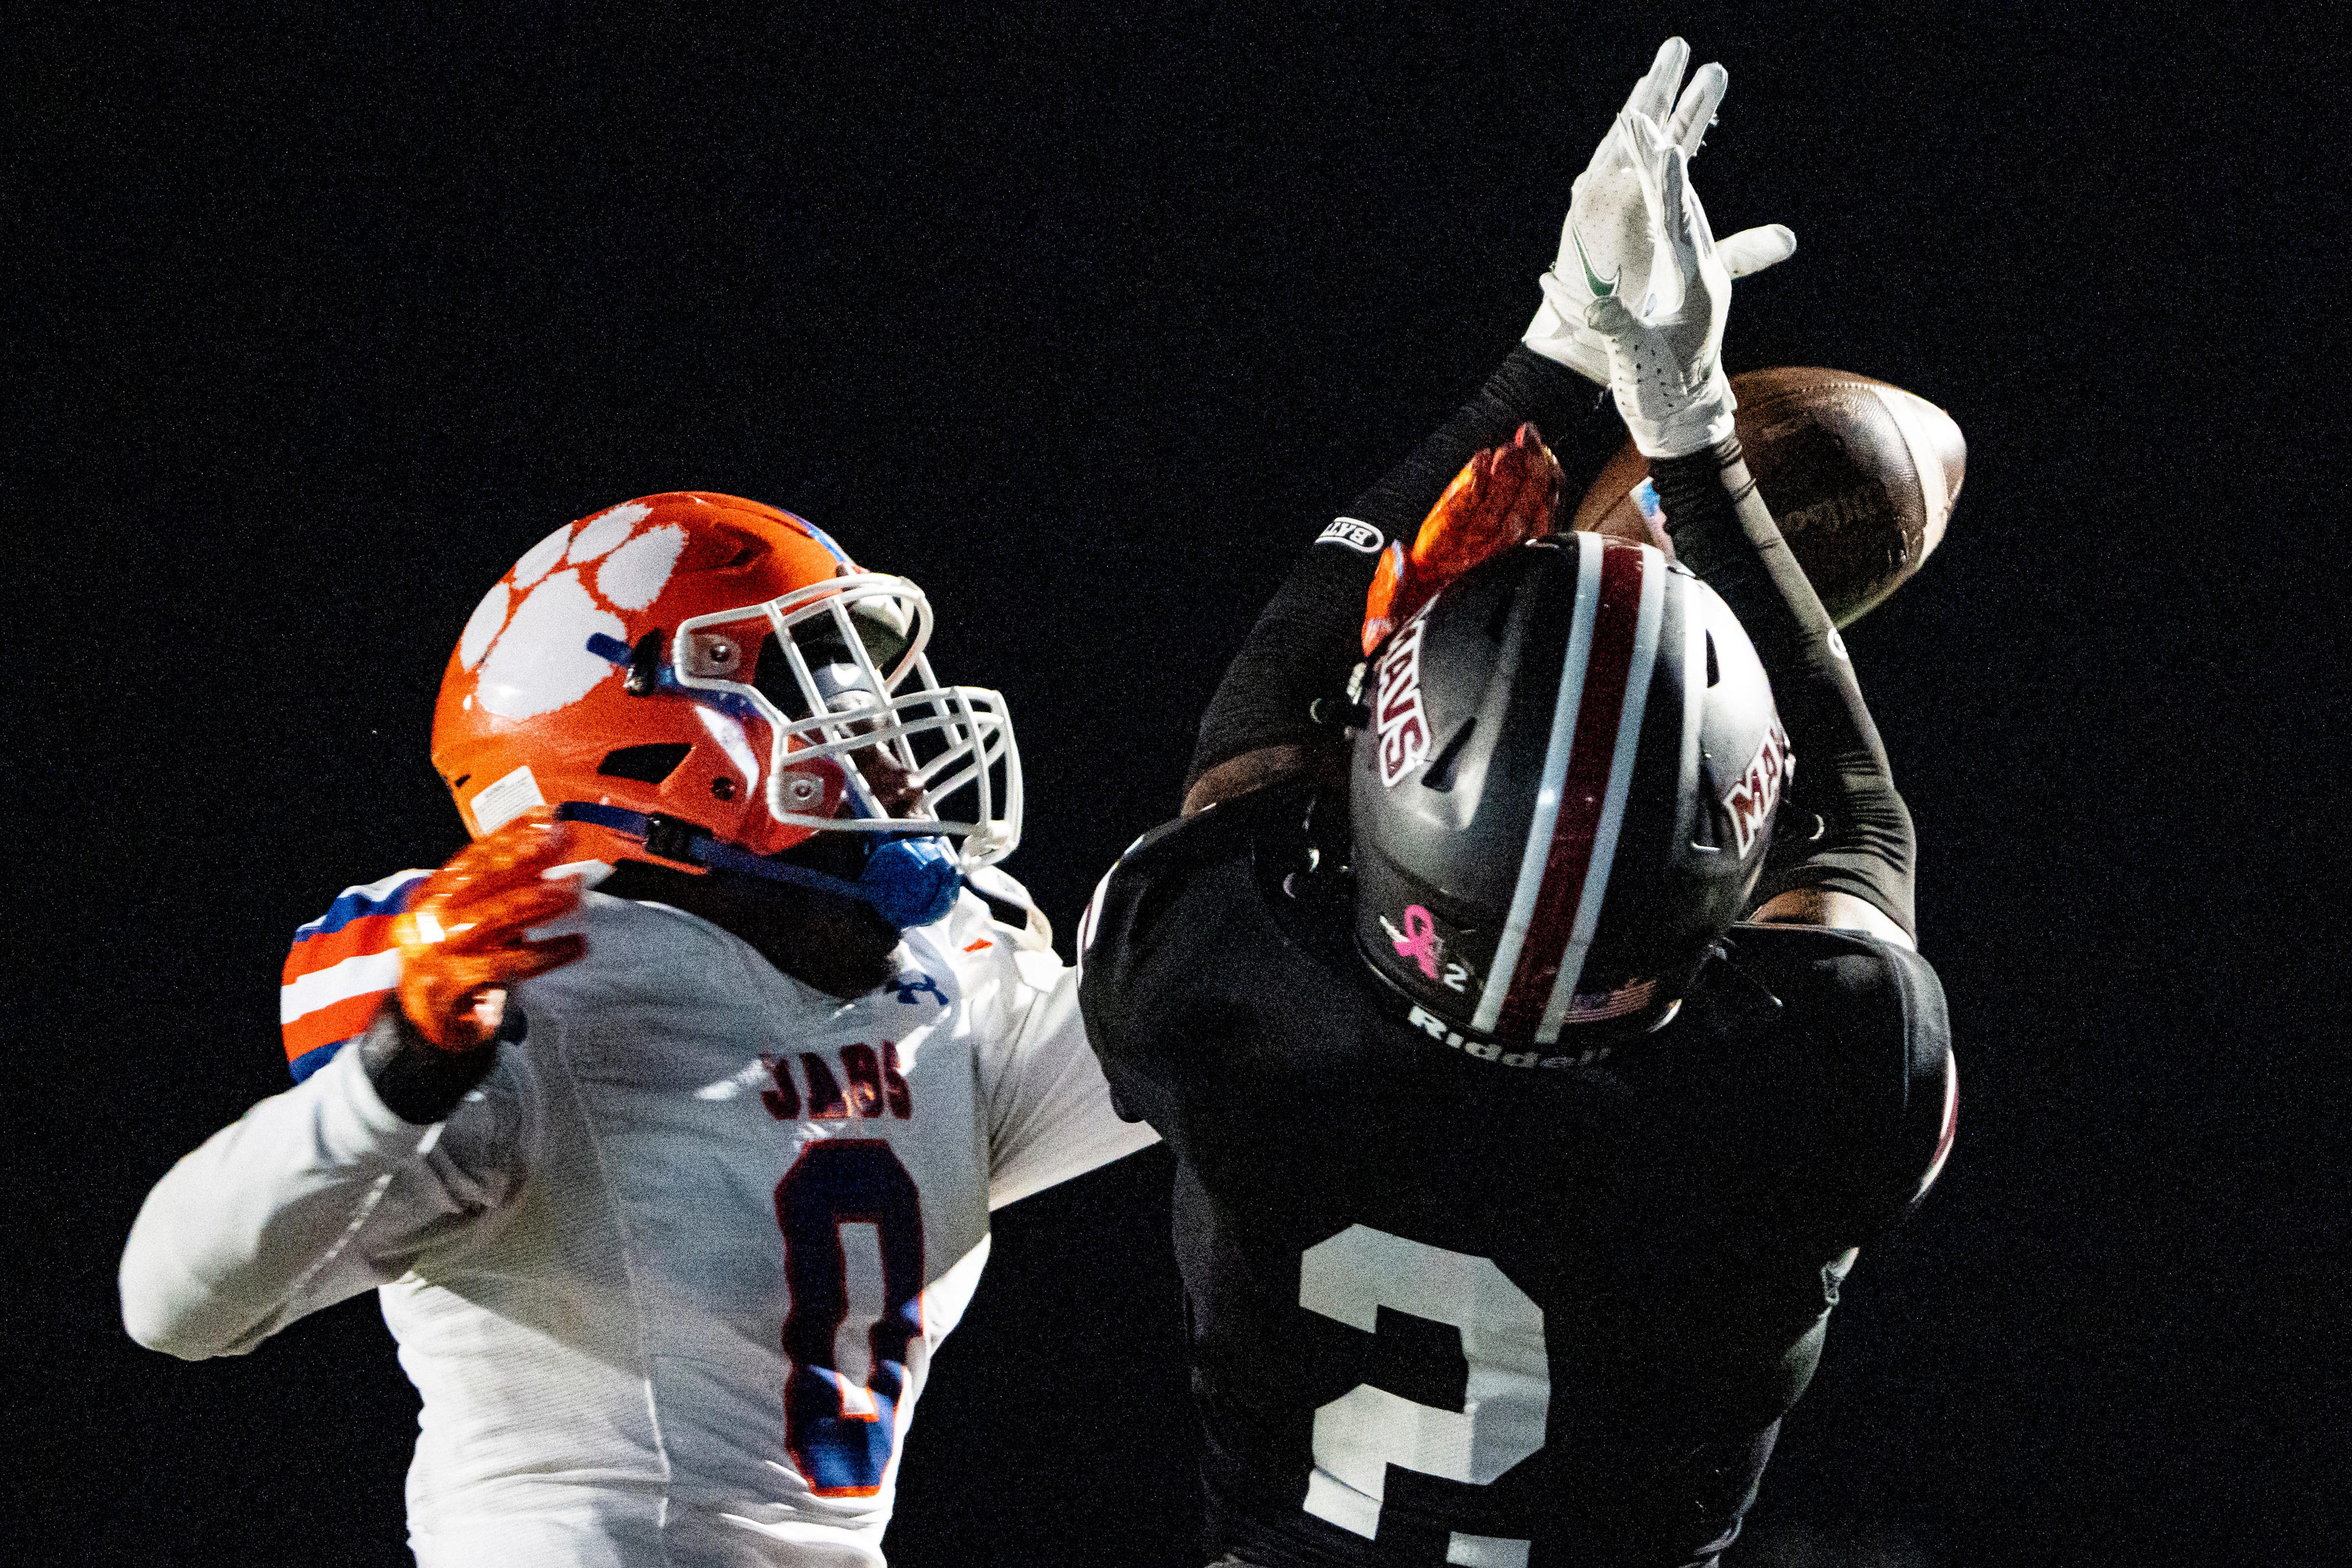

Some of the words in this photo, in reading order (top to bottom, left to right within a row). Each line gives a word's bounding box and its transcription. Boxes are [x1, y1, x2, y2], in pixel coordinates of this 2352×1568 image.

[1442, 963, 1468, 992] 2
[774, 1138, 924, 1498] 0
[1299, 1223, 1551, 1567] 2
